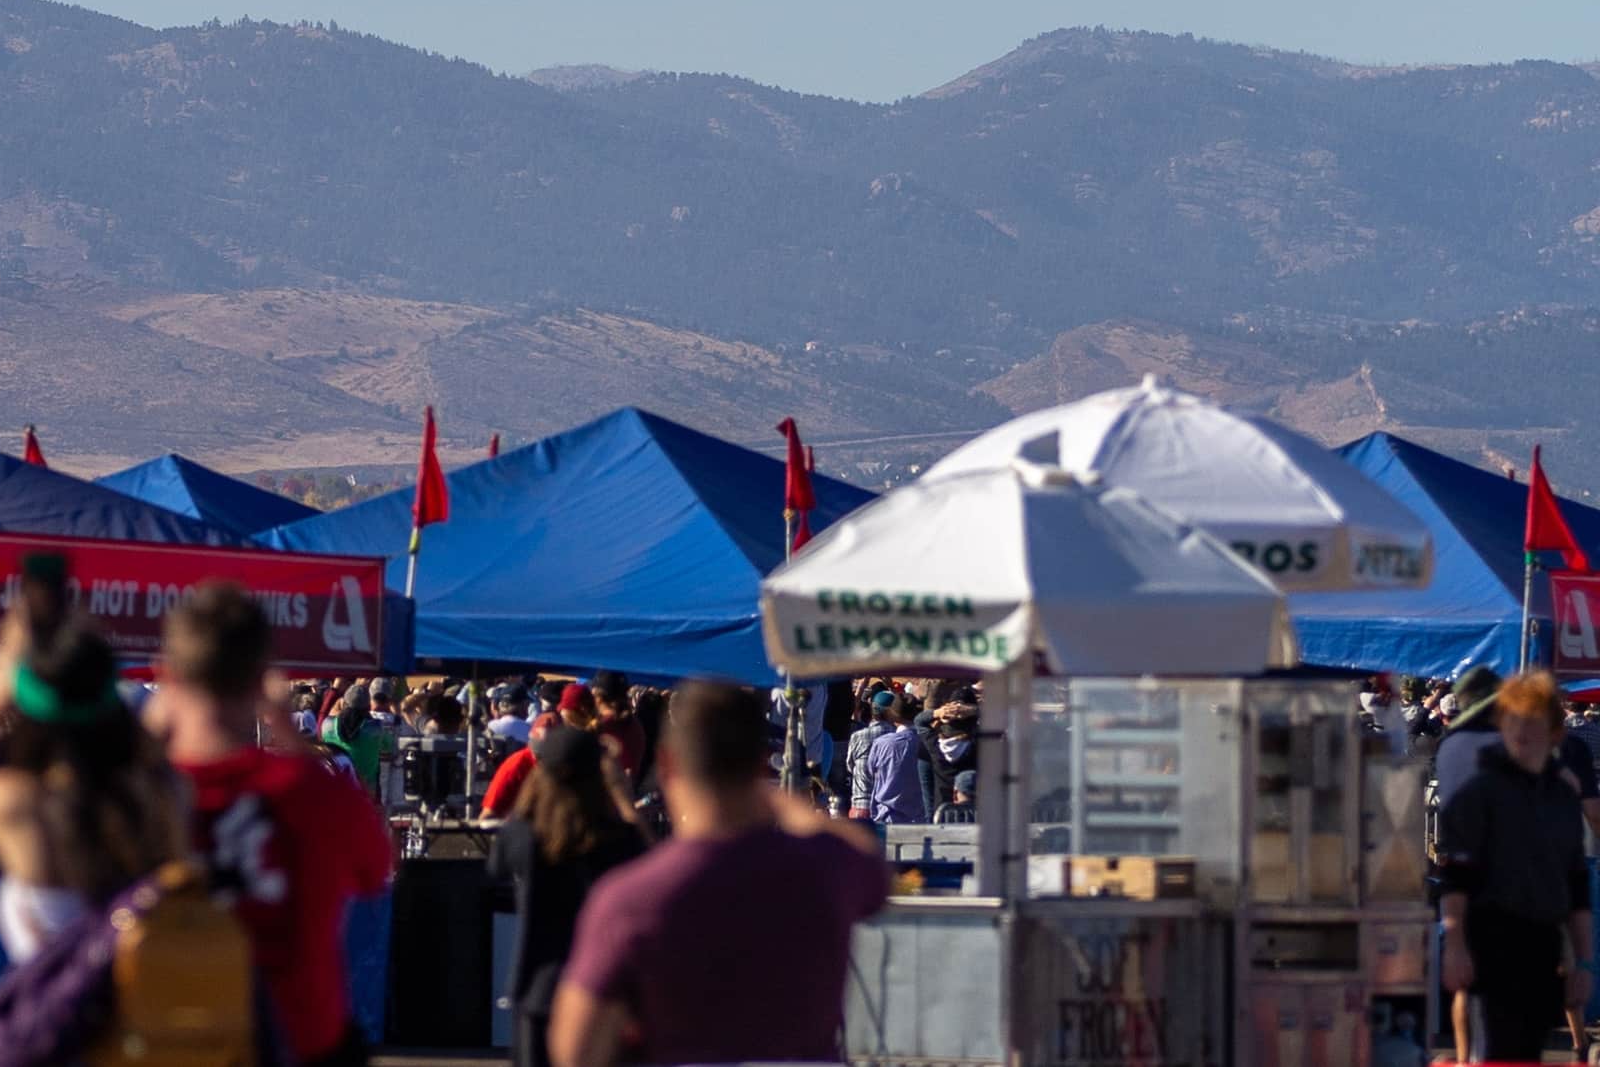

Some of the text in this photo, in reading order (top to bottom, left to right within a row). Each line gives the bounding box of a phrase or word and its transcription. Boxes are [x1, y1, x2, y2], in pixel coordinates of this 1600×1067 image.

[90, 579, 140, 617] HOT
[816, 590, 974, 616] FROZEN
[793, 622, 1010, 662] LEMONADE
